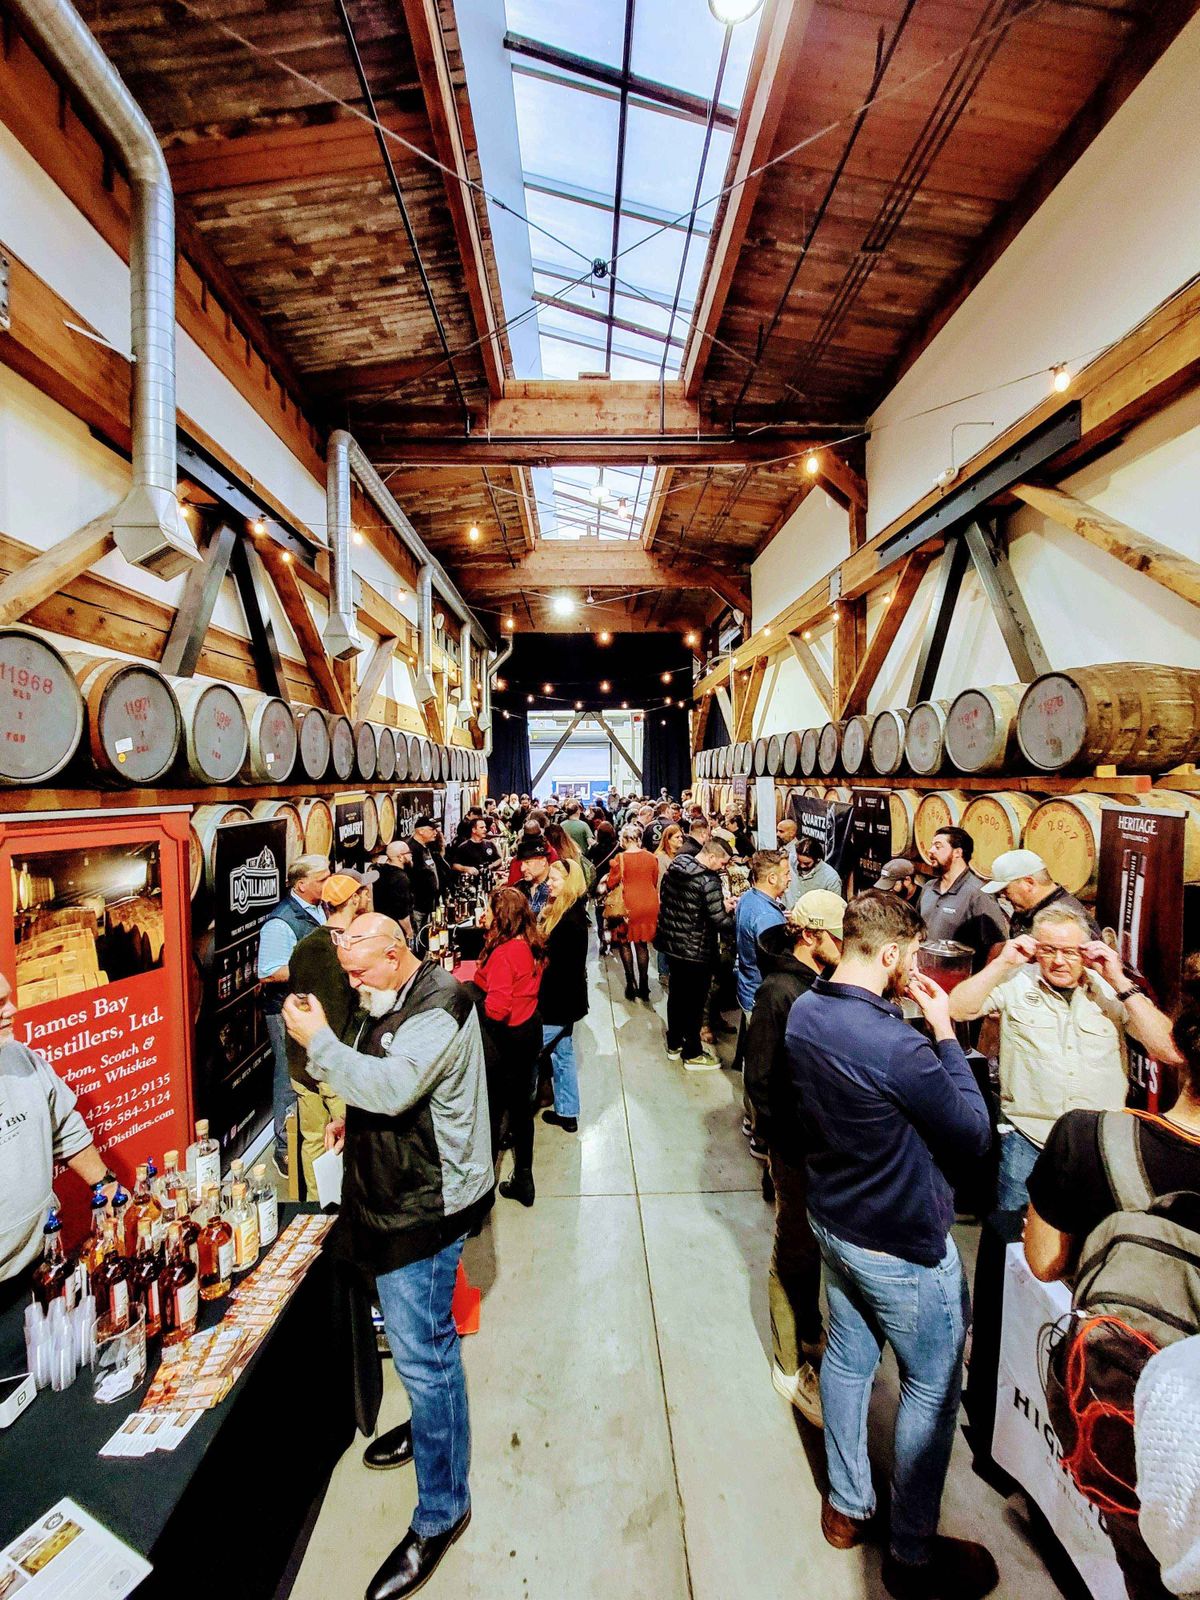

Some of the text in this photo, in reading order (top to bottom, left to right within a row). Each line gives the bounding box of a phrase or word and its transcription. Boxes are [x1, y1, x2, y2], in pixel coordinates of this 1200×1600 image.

[0, 662, 53, 694] 11968
[801, 825, 827, 841] MOUNTAIN
[802, 812, 827, 829] QUARTZ
[24, 997, 128, 1045] James Bay
[129, 1006, 164, 1032] Ltd.
[63, 1036, 155, 1083] rbon, Scotch &
[74, 1055, 157, 1097] dian Whiskies
[1130, 1049, 1159, 1094] EL'S
[86, 1073, 171, 1121] 425-212-9135
[90, 1090, 171, 1136] 778-584-3124
[5, 1112, 28, 1127] BAY
